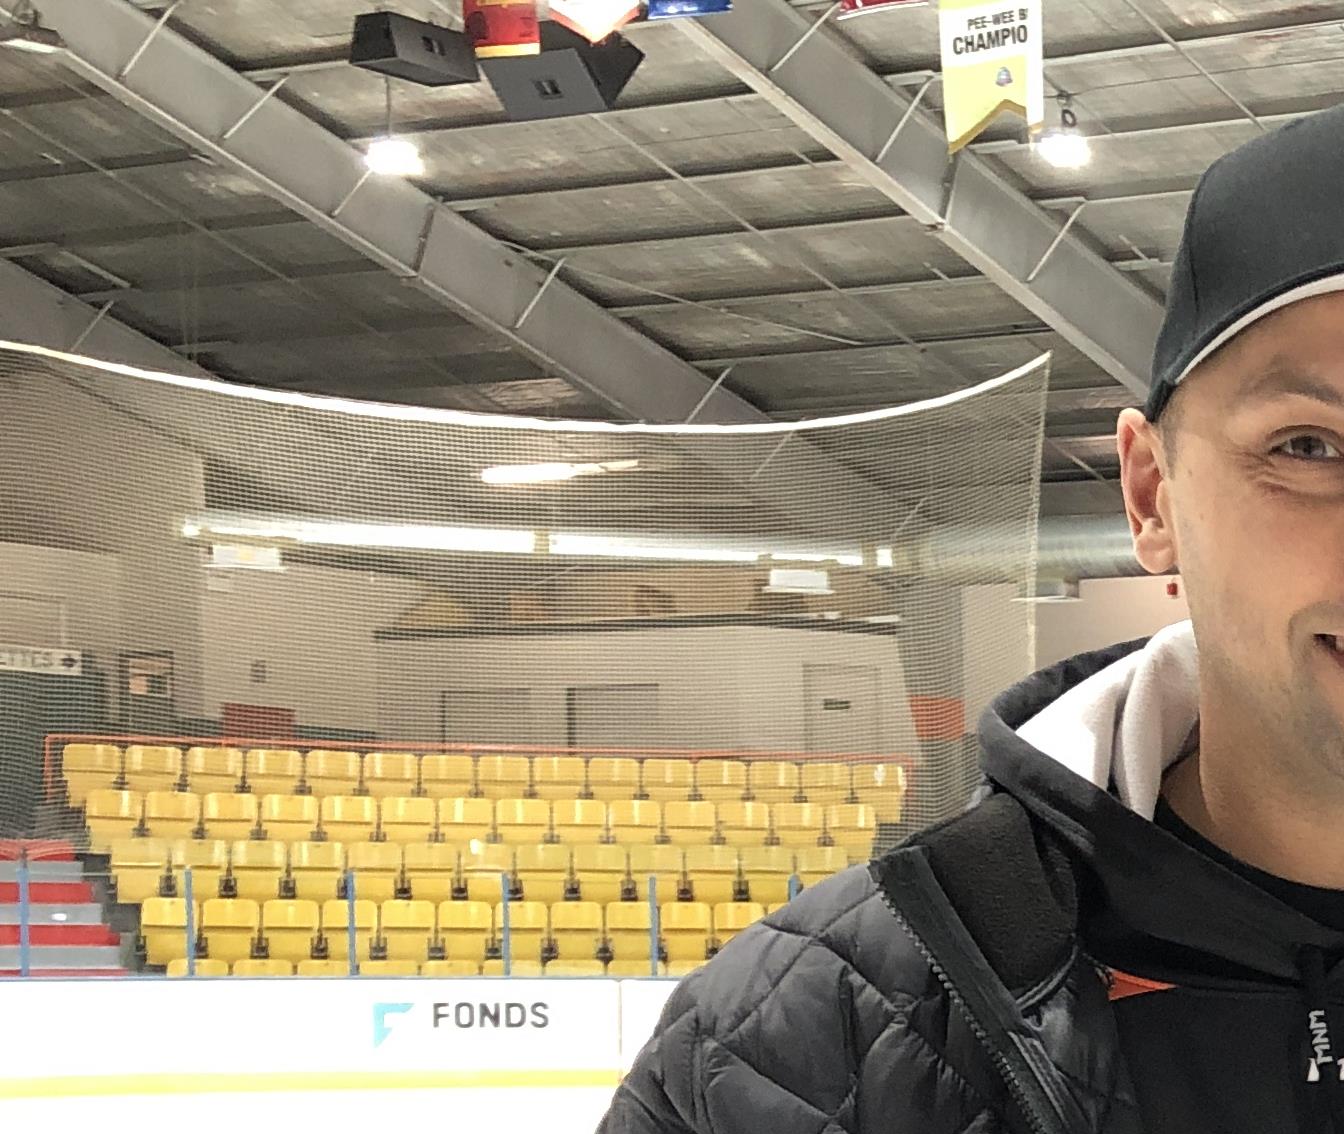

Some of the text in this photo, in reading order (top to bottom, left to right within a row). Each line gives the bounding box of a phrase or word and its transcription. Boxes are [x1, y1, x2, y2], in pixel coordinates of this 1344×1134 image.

[967, 10, 1015, 30] PEE-WEE
[953, 24, 1028, 55] CHAMPIO
[433, 1002, 550, 1029] FONDS
